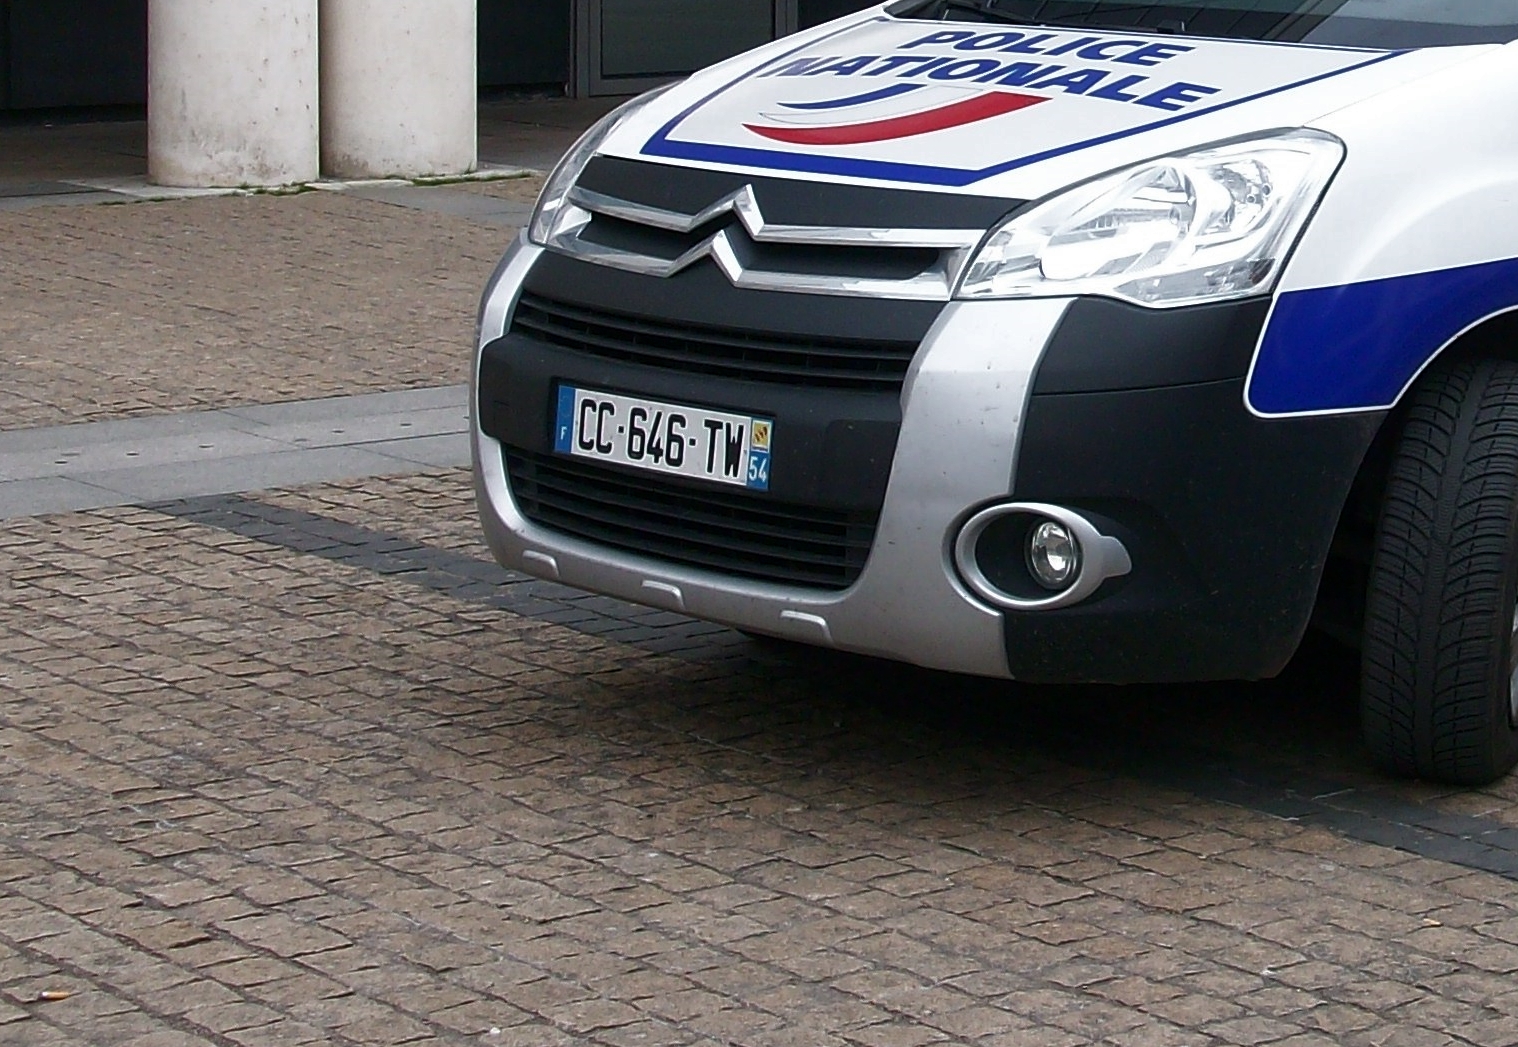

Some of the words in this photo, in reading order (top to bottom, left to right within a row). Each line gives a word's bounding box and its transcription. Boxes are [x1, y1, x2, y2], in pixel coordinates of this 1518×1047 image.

[898, 30, 1197, 66] POLICE
[756, 56, 1222, 112] NATIONALE
[560, 426, 567, 440] F
[749, 456, 767, 483] 54
